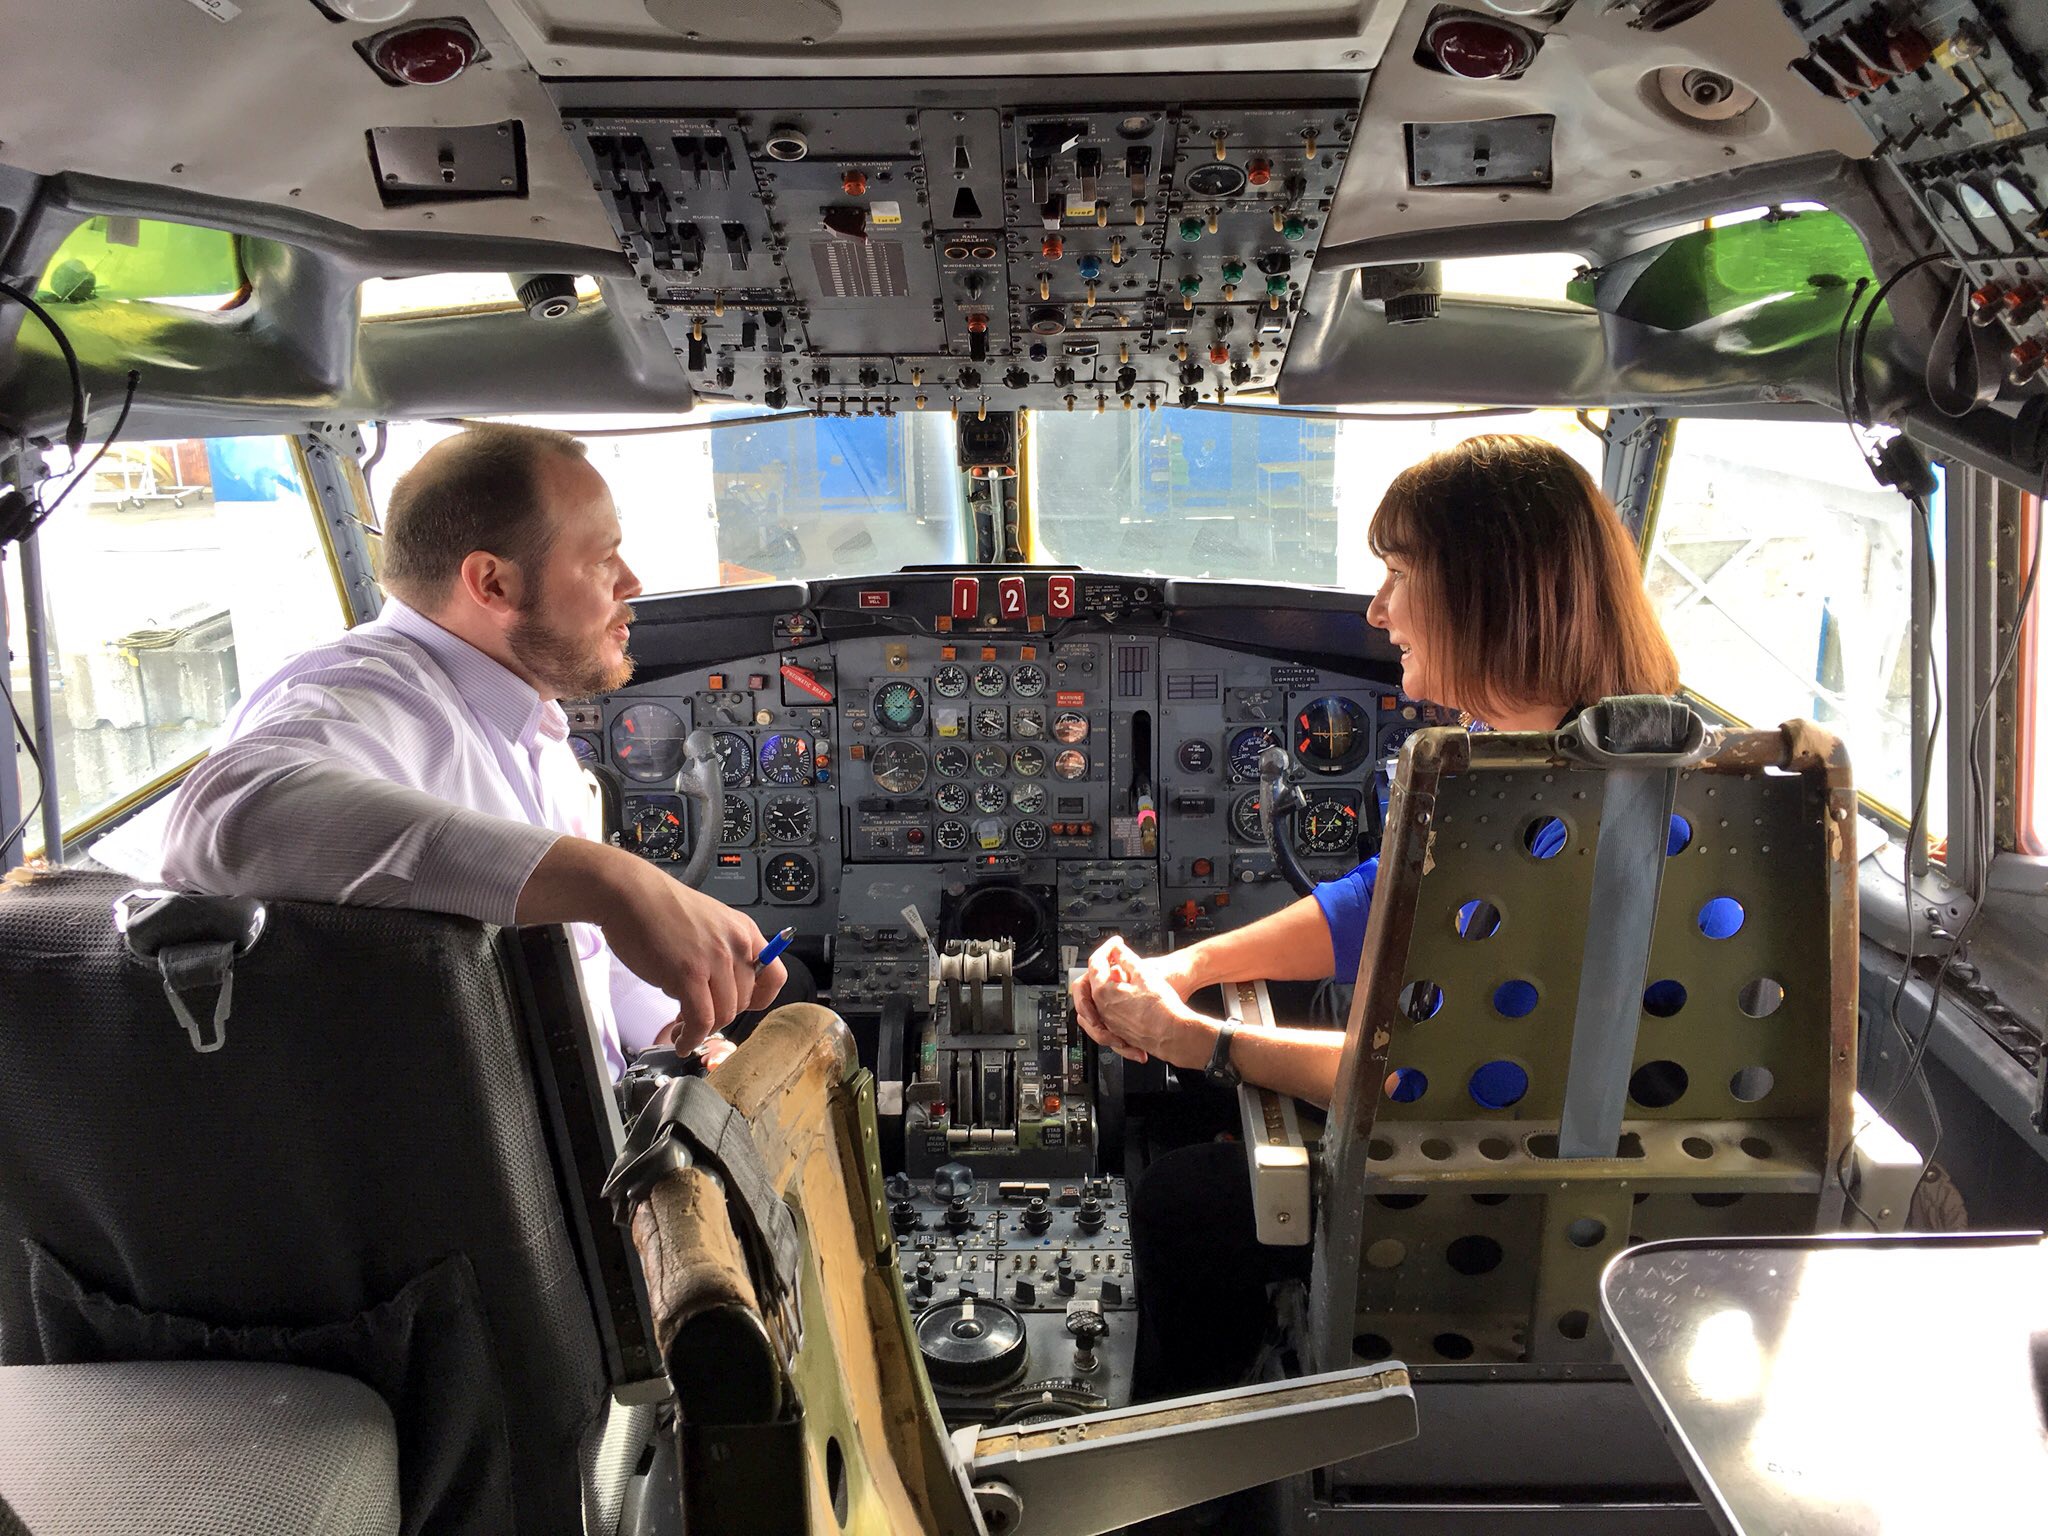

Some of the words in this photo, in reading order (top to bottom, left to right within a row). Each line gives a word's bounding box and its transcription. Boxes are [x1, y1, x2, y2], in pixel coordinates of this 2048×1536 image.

[962, 588, 968, 611] 1
[1005, 589, 1020, 612] 2
[1053, 586, 1070, 609] 3
[786, 669, 812, 688] PNEUMATIC
[812, 684, 828, 698] BRAKE
[924, 1064, 932, 1072] 10
